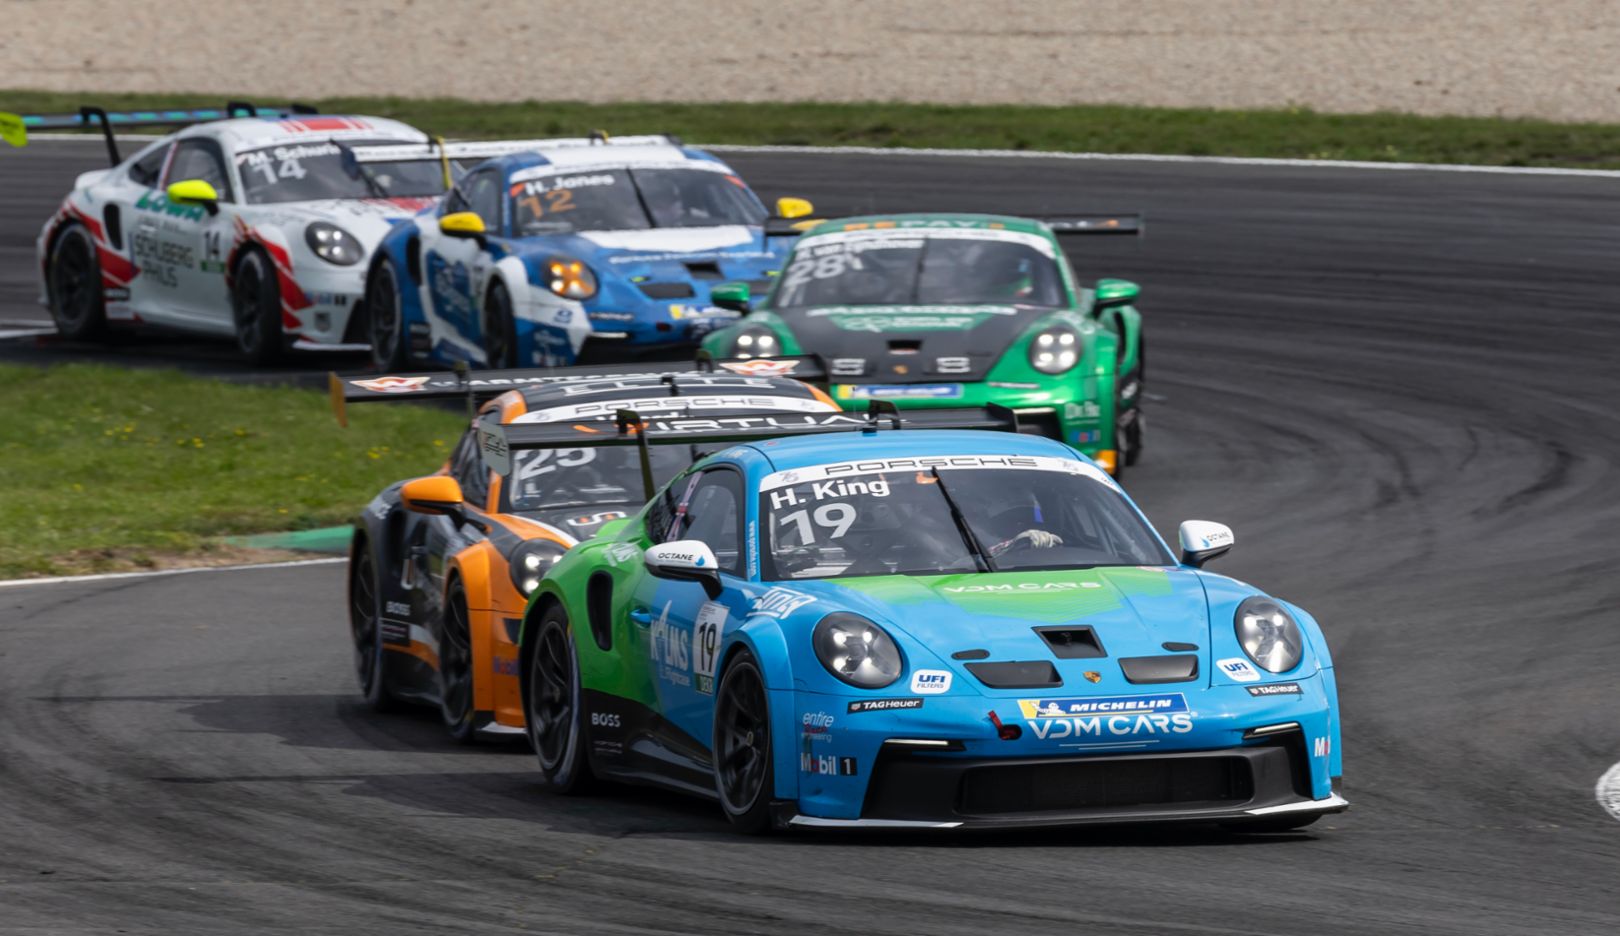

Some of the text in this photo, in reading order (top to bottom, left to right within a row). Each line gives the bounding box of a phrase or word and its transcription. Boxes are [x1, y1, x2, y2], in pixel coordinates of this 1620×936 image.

[253, 159, 307, 184] 14
[525, 181, 550, 196] H.
[520, 189, 576, 218] 12
[205, 230, 219, 260] 14
[784, 254, 846, 287] 28
[575, 398, 774, 414] PORSCHE
[514, 447, 597, 480] 25
[825, 457, 1039, 476] PORSCHE
[770, 480, 890, 510] H. King
[779, 503, 857, 545] 19
[657, 552, 695, 561] OCTANE
[699, 622, 717, 672] 19
[918, 674, 946, 683] UFI
[1224, 662, 1248, 672] UFI
[1070, 699, 1172, 712] MICHELIN
[591, 712, 621, 727] BOSS
[802, 711, 834, 728] entire
[1028, 714, 1193, 739] VDM CARS
[801, 752, 851, 775] Mobil 1
